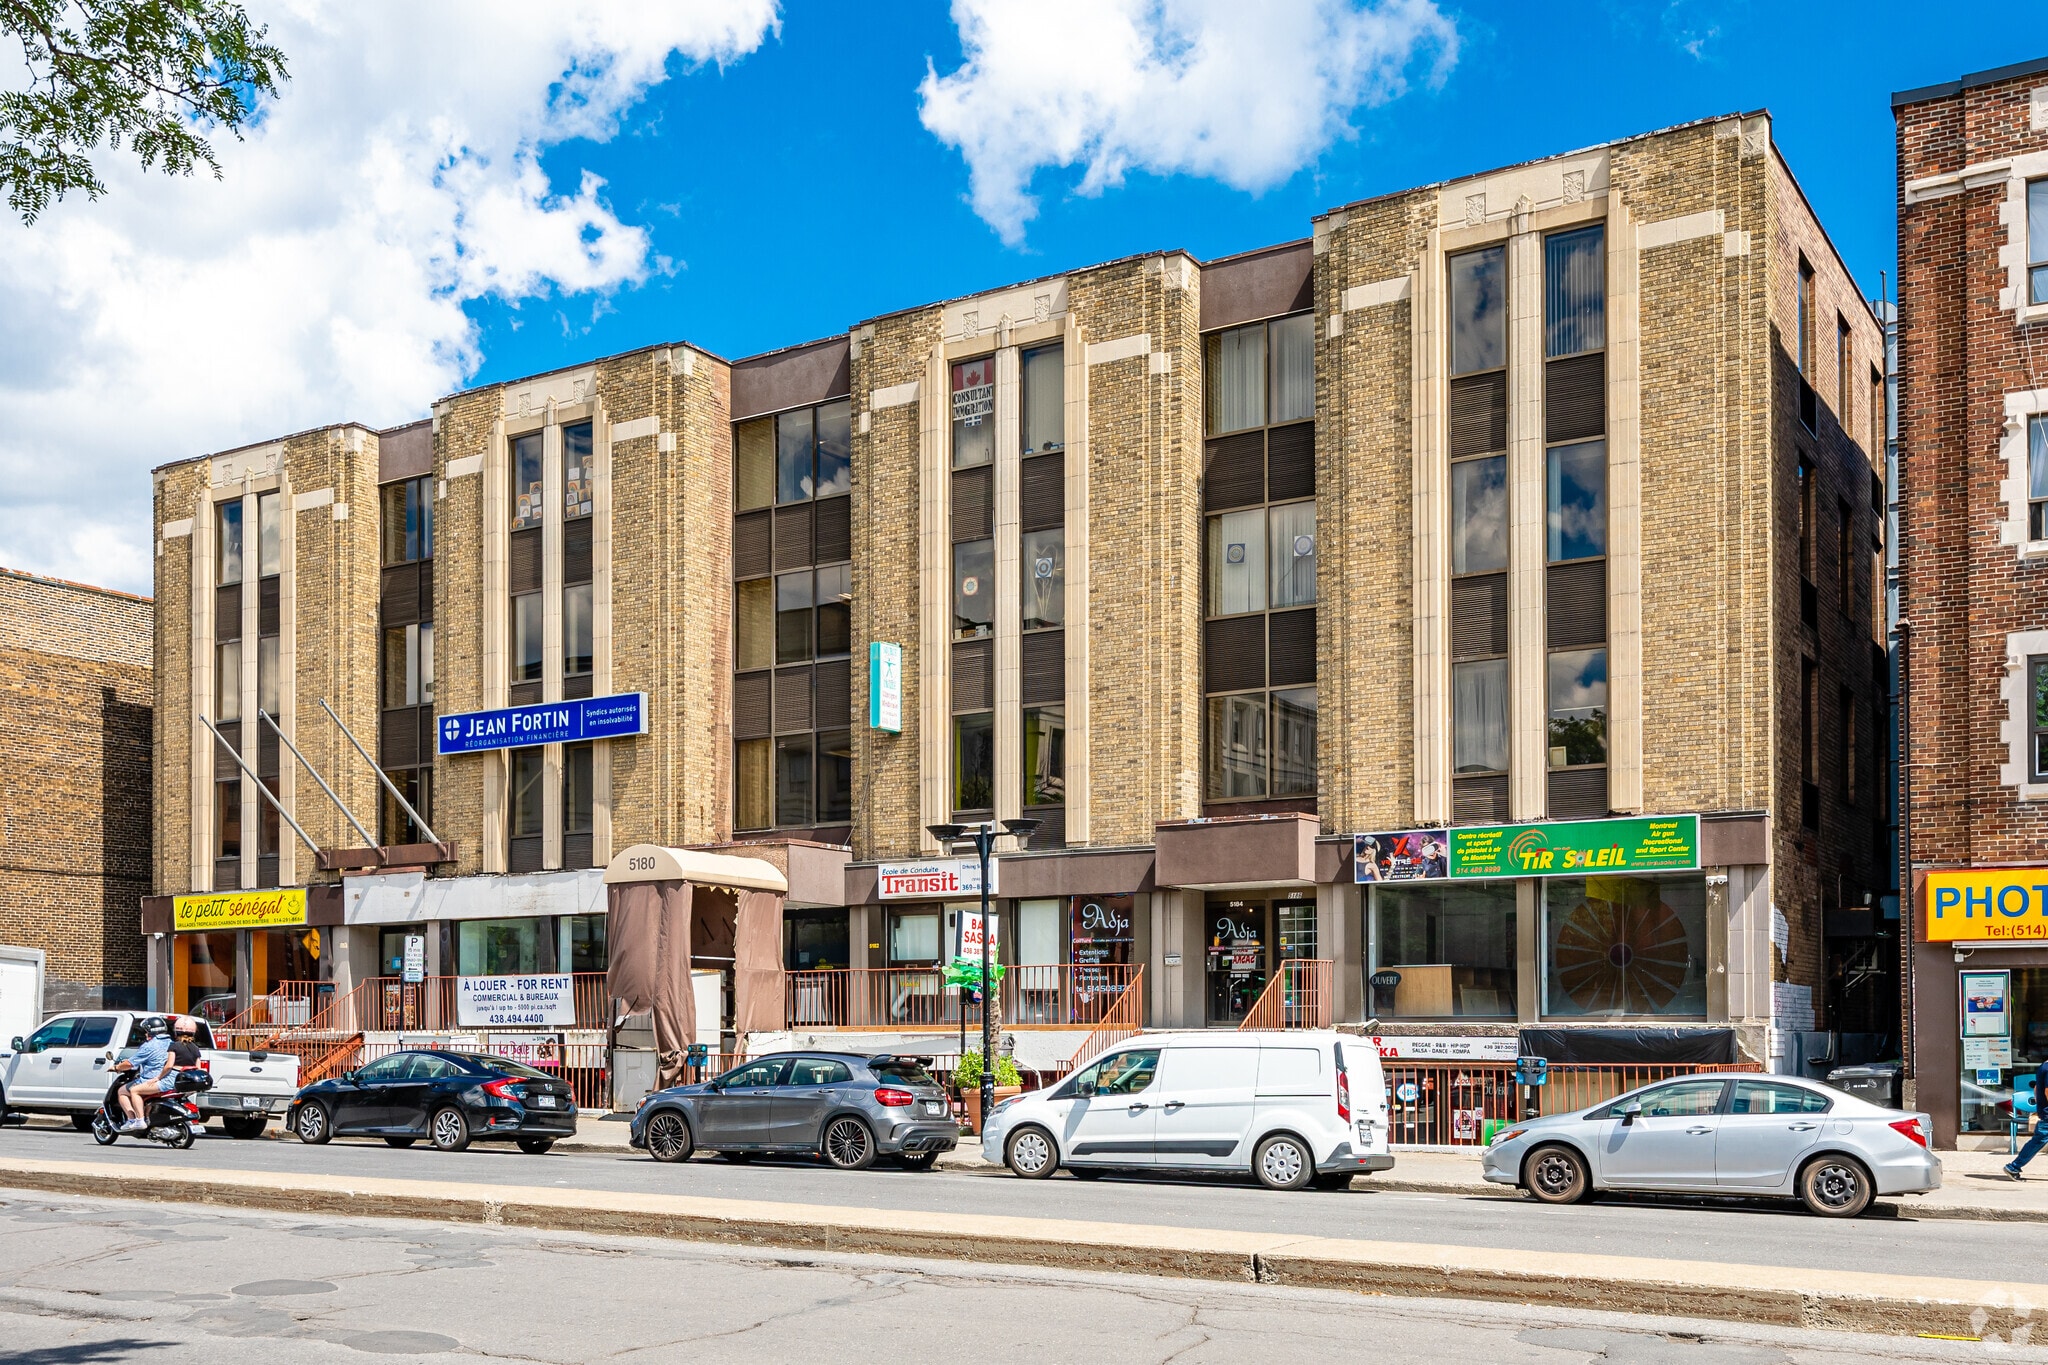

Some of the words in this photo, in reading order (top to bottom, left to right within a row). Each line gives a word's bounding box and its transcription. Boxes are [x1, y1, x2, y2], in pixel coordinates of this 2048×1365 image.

[953, 386, 993, 404] CONSULTANT
[586, 708, 607, 718] Syndics
[608, 705, 636, 714] autorisés
[466, 716, 506, 738] JEAN
[512, 709, 569, 733] FORTIN
[597, 714, 633, 725] insolvabilité
[464, 735, 524, 748] RÉORGANISATION
[526, 730, 569, 742] FINANCIÈRE
[1473, 839, 1493, 847] sportif
[1643, 837, 1683, 845] Recreational
[1649, 846, 1667, 854] Sport
[629, 856, 656, 870] 5180
[910, 865, 939, 873] Conduite
[882, 871, 959, 894] Transit
[194, 899, 231, 922] petit
[229, 894, 285, 919] sénégal
[1082, 903, 1129, 936] Adja
[1217, 917, 1257, 945] Adja
[411, 937, 418, 947] P
[964, 931, 996, 946] SASA
[463, 978, 470, 991] À
[473, 980, 507, 991] LOUER
[518, 979, 538, 990] FOR
[541, 978, 569, 989] RENT
[1371, 976, 1397, 984] OUVERT
[473, 994, 518, 1002] COMMERCIAL
[526, 993, 559, 1001] BUREAUX
[476, 1004, 495, 1012] jusqu'à
[489, 1014, 544, 1024] 438.494.4400
